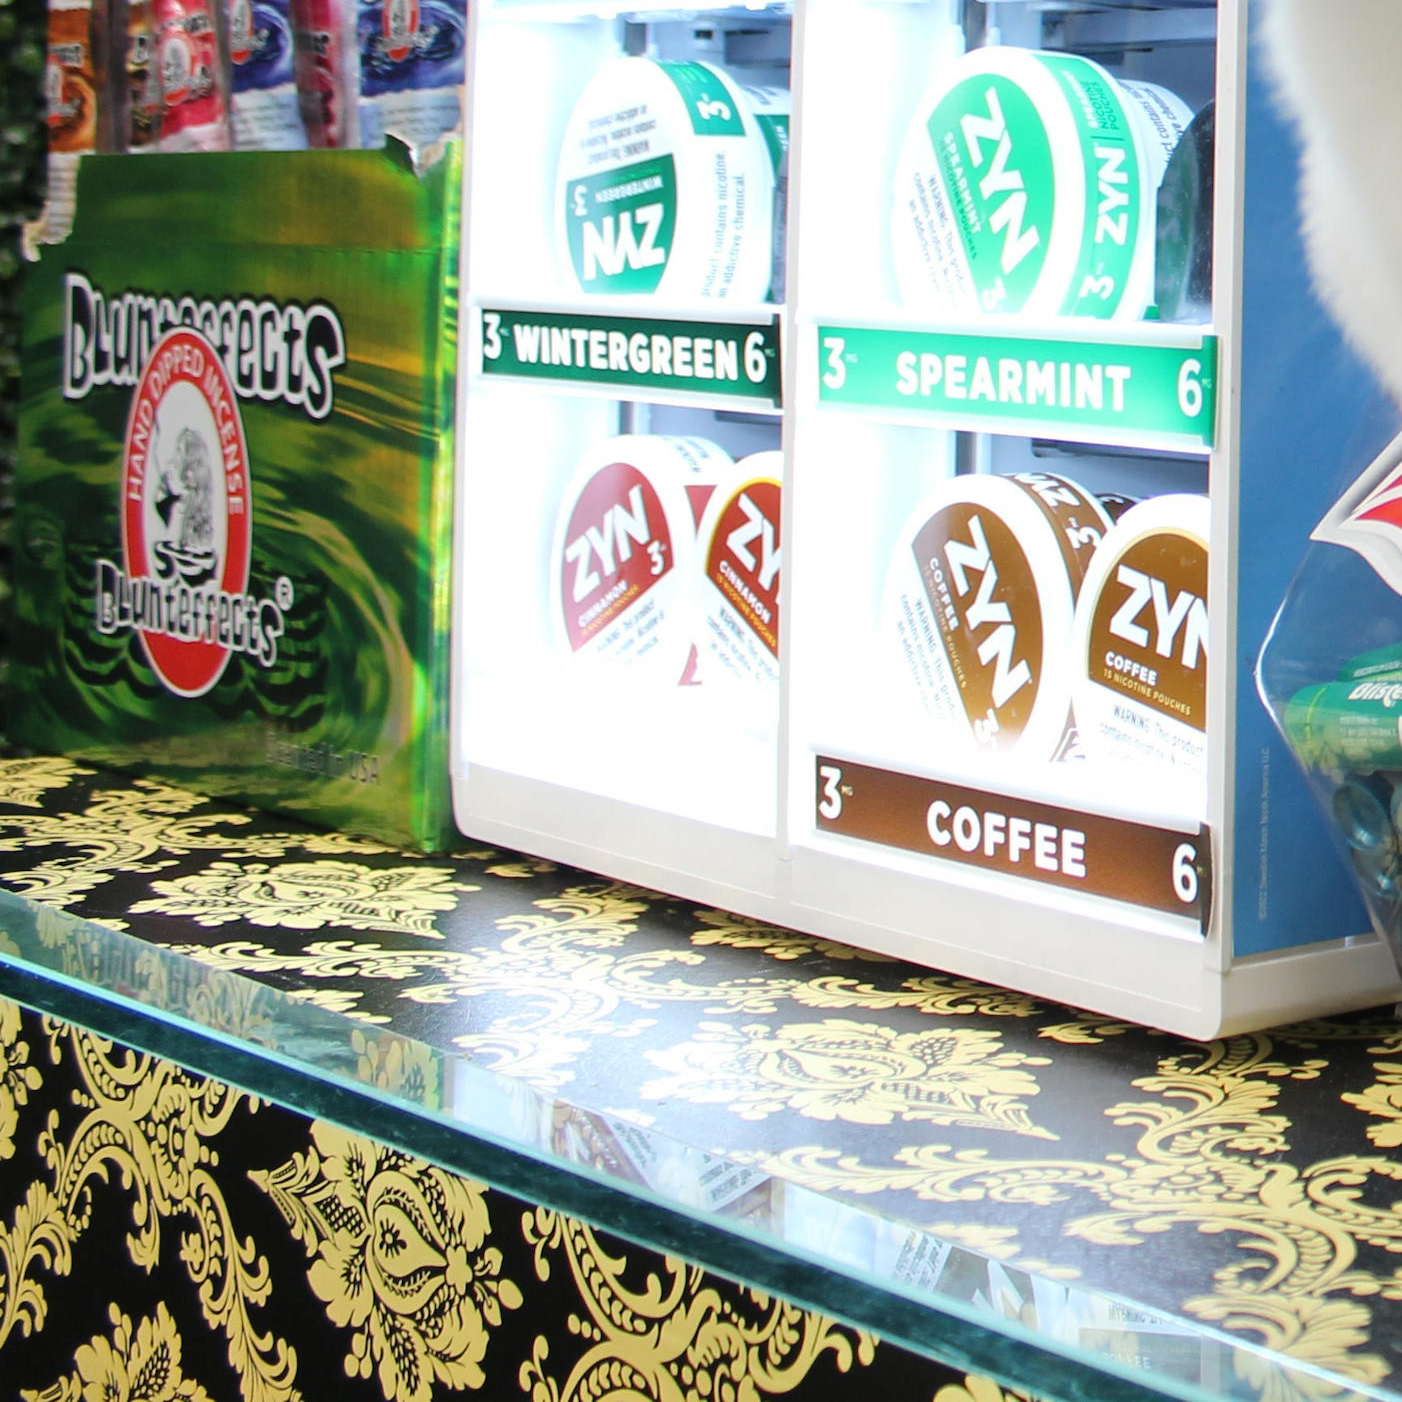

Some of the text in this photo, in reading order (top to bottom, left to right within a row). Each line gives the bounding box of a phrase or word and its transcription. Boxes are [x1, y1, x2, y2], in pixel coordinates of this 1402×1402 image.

[696, 93, 732, 122] 3
[1078, 80, 1110, 130] NICOTINE
[1090, 80, 1120, 131] POUCHES
[572, 184, 589, 218] 3
[943, 130, 984, 236] SPEARMINT
[960, 85, 1041, 277] ZYN
[581, 202, 666, 282] ZYN
[1079, 145, 1130, 301] 3 ZYN
[483, 312, 768, 383] 3 WINTERGREEN 6
[822, 337, 847, 389] 3
[895, 350, 1132, 412] SPEARMINT
[1176, 358, 1203, 418] 6
[127, 344, 245, 515] HAND DIPPED INCENSE
[565, 483, 651, 603] ZYN
[646, 540, 665, 576] 3
[725, 492, 782, 606] ZY
[577, 579, 628, 629] CINNAMON
[718, 559, 772, 625] CINNAMON
[928, 557, 958, 632] COFFEE
[942, 514, 1032, 710] ZYN
[944, 635, 969, 689] POUCHES
[1105, 650, 1158, 687] COFFEE
[1113, 671, 1153, 698] NICOTINE
[1153, 690, 1192, 717] POUCHES
[347, 749, 382, 786] USA
[818, 765, 843, 821] 3
[926, 799, 1087, 879] COFFEE
[1171, 841, 1199, 905] 6
